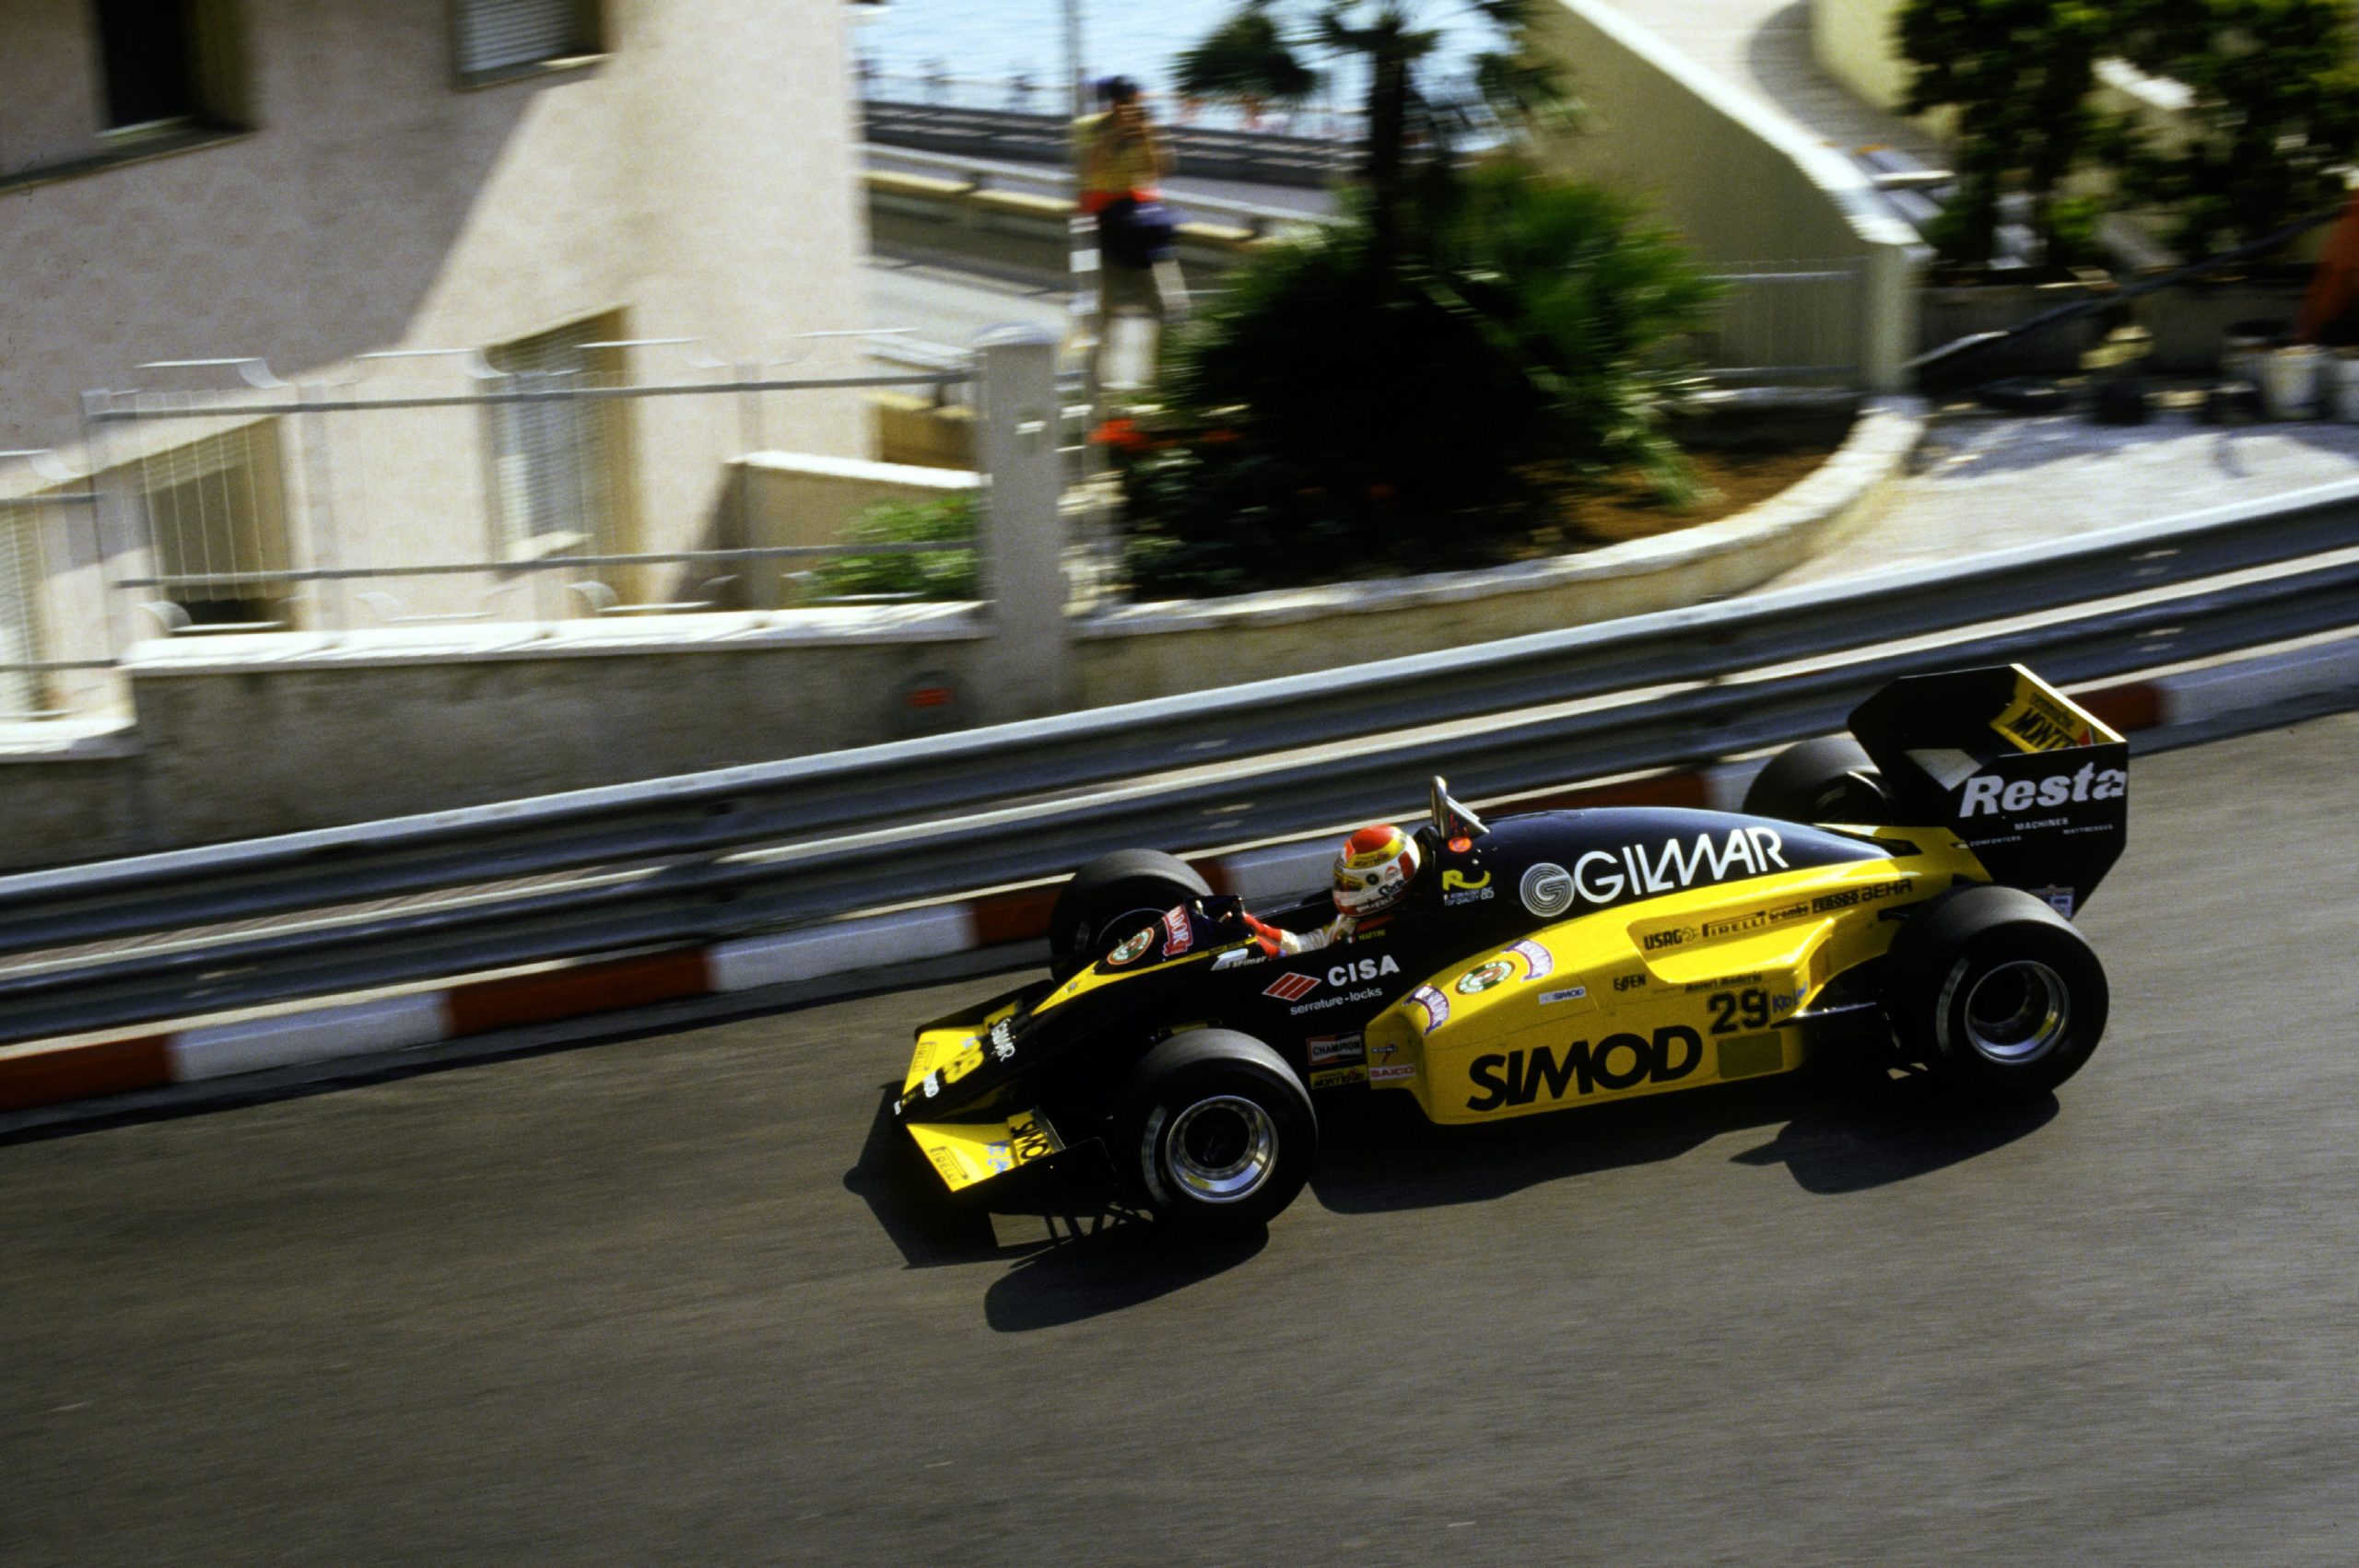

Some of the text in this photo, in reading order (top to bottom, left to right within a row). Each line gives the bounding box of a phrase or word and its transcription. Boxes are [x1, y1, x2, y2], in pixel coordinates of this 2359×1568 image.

[1959, 762, 2127, 818] Resta
[2013, 816, 2070, 831] MACHINES
[1573, 827, 1790, 905] GILMAR
[1813, 890, 1859, 913] FERODO
[1861, 879, 1913, 903] BEHR
[1701, 910, 1766, 938] PIRELLI
[1643, 928, 1684, 951] USAG
[1327, 954, 1401, 987] CISA
[1708, 988, 1768, 1034] 29
[1312, 1039, 1361, 1057] CHAMPION
[1370, 1066, 1414, 1078] SAICO
[1466, 1024, 1703, 1112] SIMOD
[1011, 1119, 1050, 1161] SIMO
